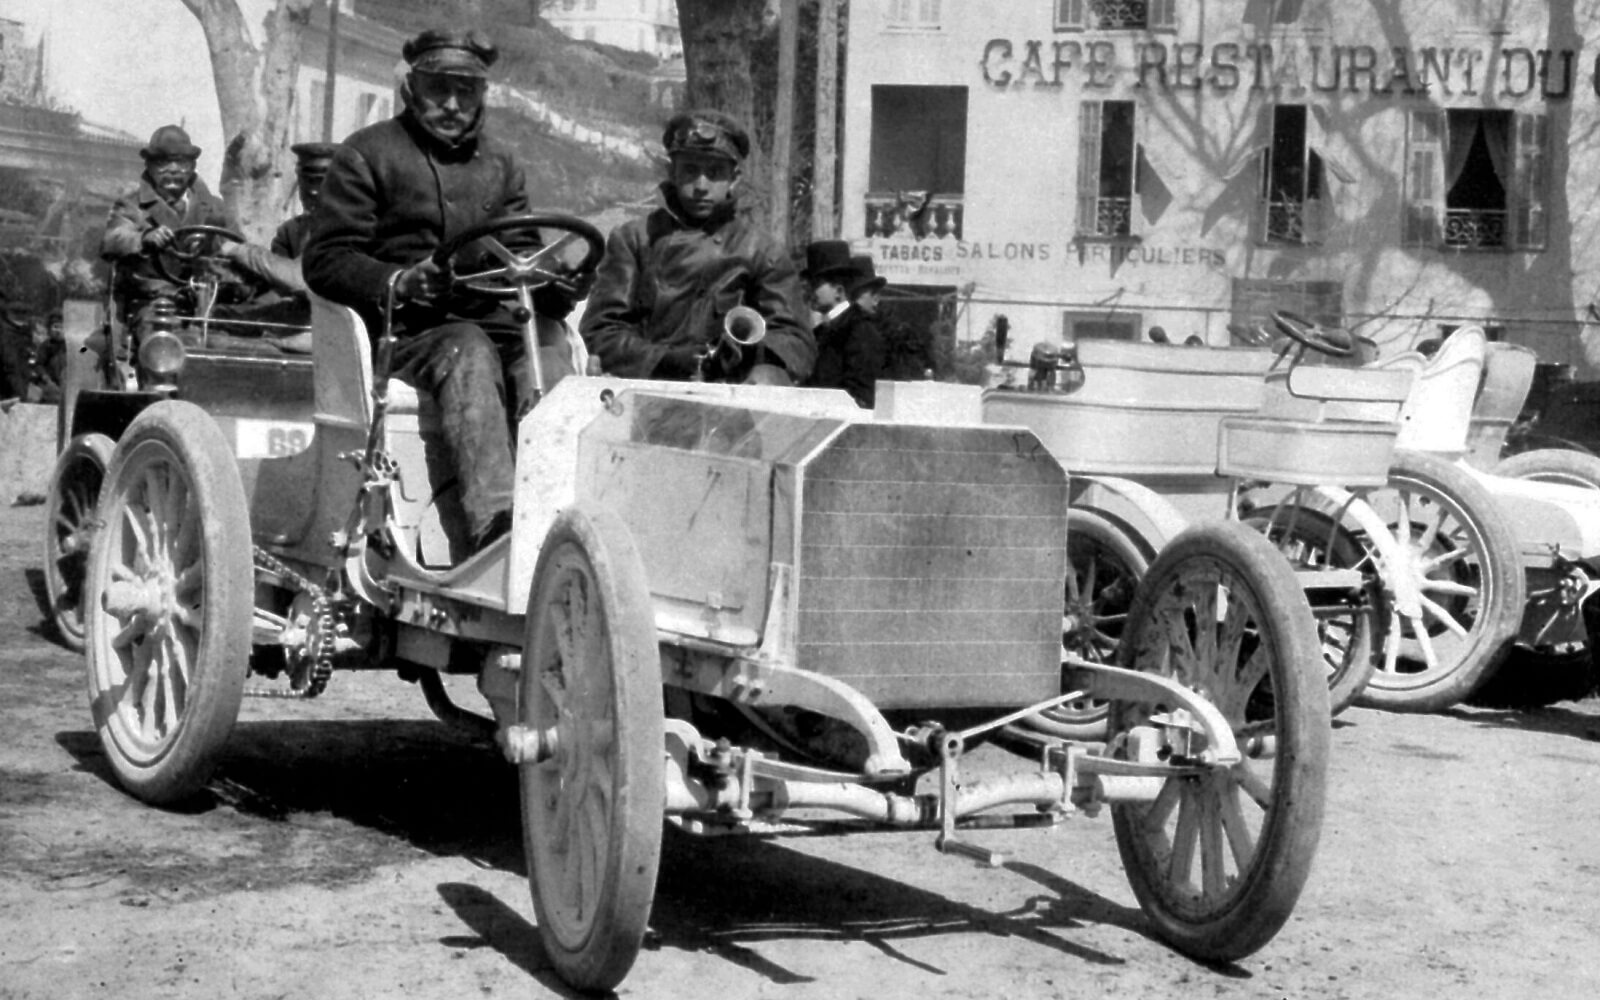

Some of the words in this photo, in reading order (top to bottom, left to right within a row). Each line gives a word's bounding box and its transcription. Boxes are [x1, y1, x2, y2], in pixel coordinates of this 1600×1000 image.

[980, 38, 1115, 88] CAFE
[1134, 41, 1483, 97] RESTAURANT
[1500, 47, 1574, 99] DU
[880, 245, 942, 262] TABACS
[956, 241, 1051, 260] SALONS
